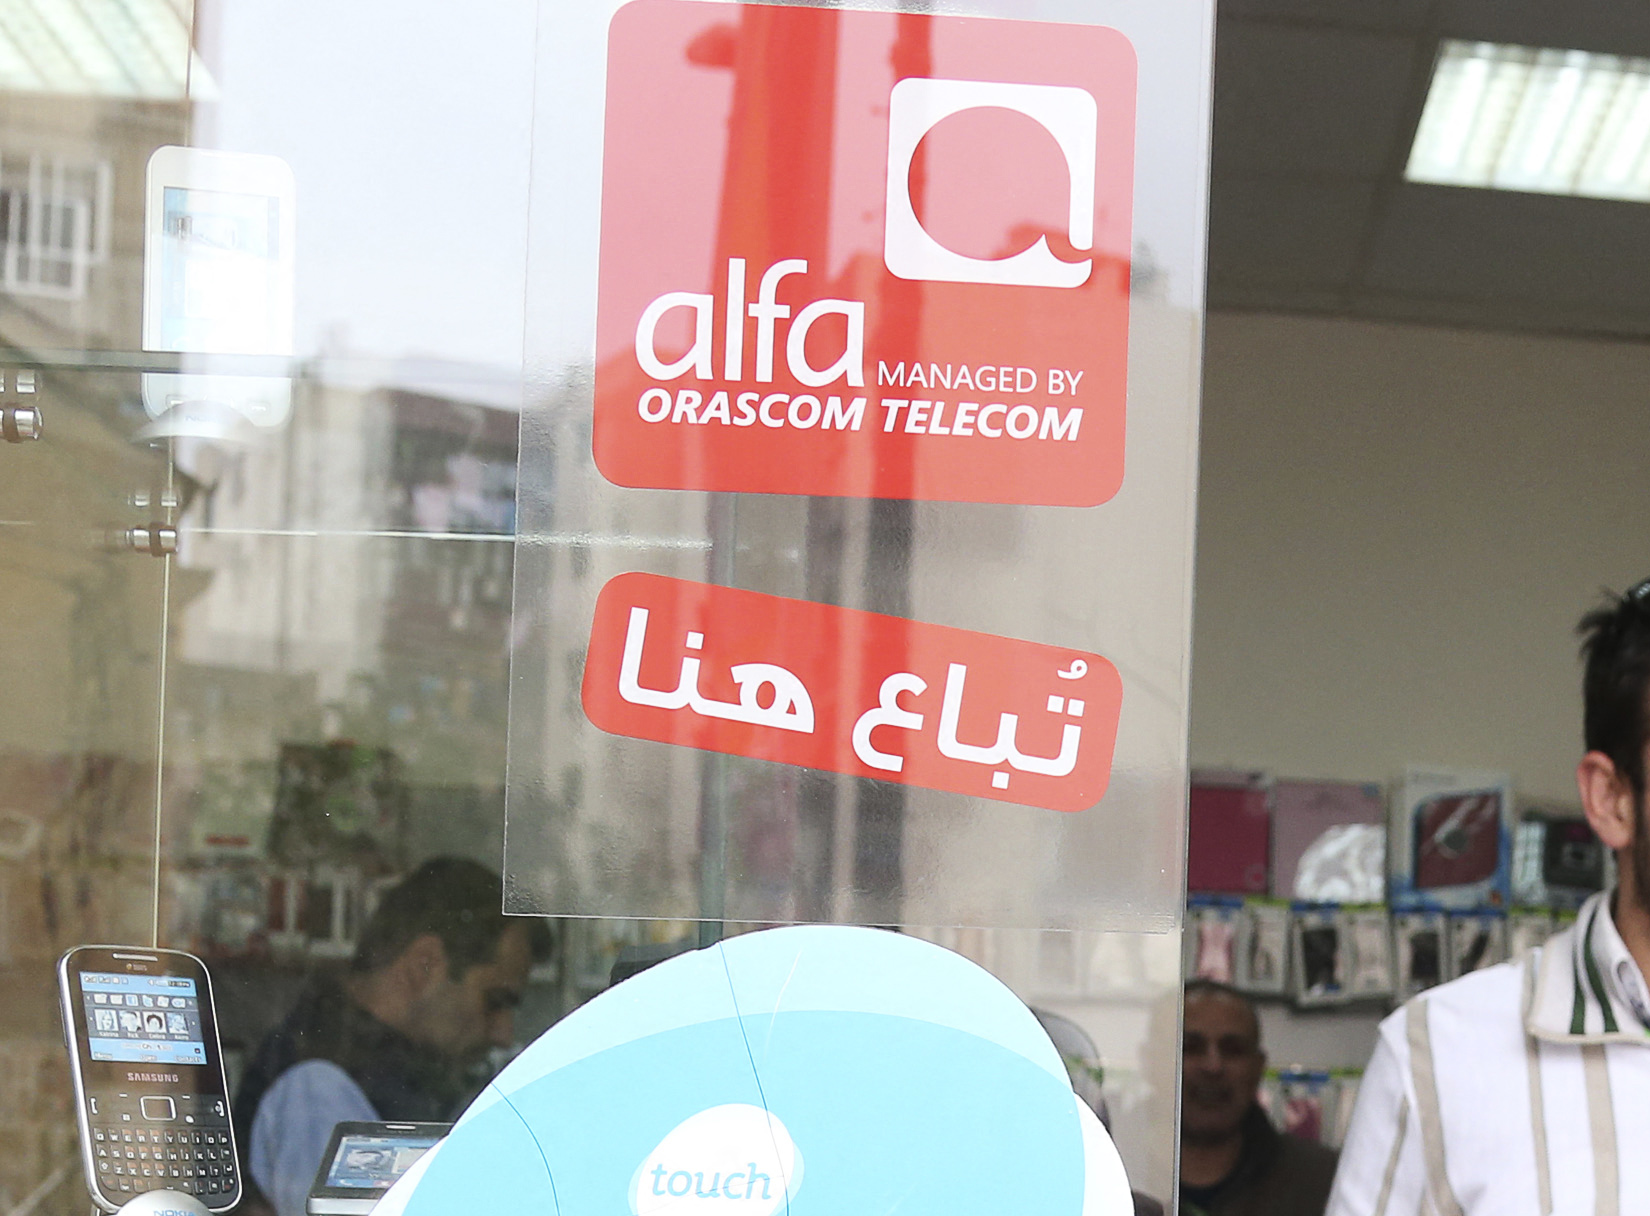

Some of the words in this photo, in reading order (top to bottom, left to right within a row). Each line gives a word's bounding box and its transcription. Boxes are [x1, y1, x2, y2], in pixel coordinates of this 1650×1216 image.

[633, 257, 867, 389] alfa
[877, 360, 1038, 394] MANAGED
[1047, 367, 1084, 397] BY
[637, 390, 864, 433] ORASCOM
[880, 398, 1084, 442] TELECOM
[616, 606, 816, 735] هنا
[127, 1072, 179, 1083] SAMSUNG
[651, 1162, 771, 1200] touch
